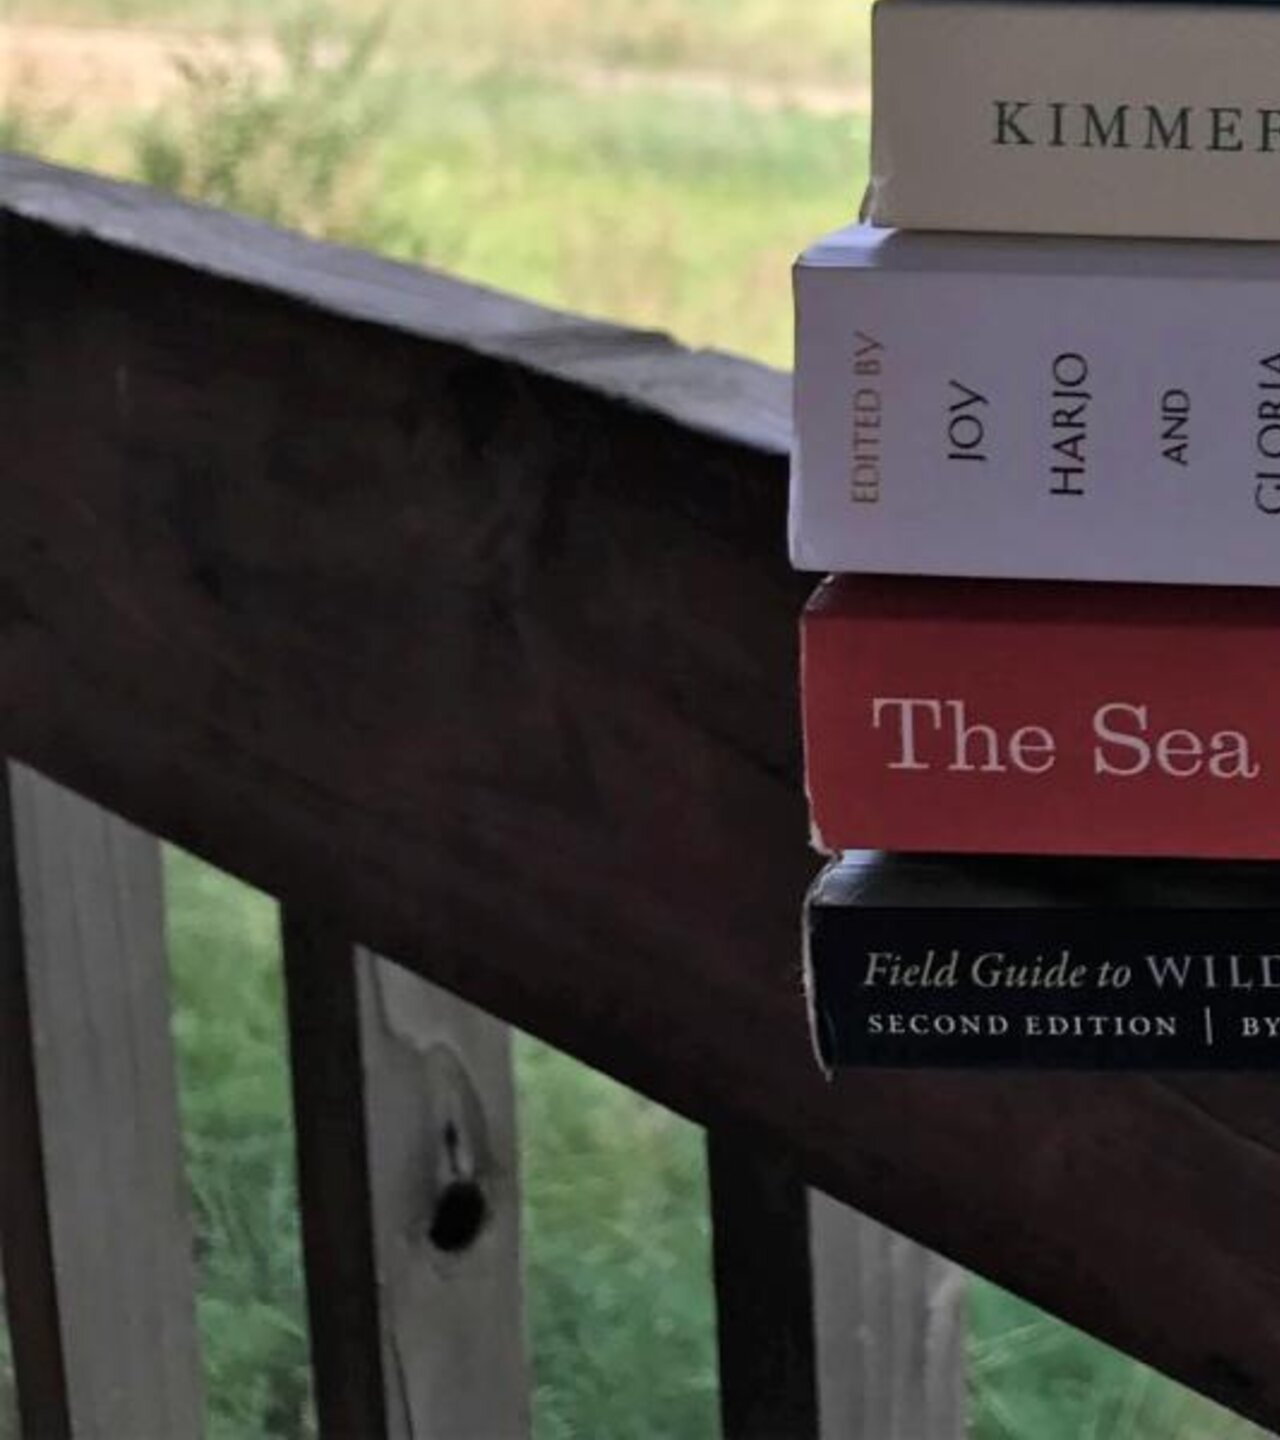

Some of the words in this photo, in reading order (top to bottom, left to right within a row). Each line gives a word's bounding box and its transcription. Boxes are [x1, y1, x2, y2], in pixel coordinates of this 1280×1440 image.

[854, 332, 883, 376] BY
[852, 387, 881, 504] EDITED
[947, 379, 988, 462] JOY
[1050, 352, 1088, 496] HARJO
[1160, 389, 1190, 465] AND
[872, 697, 1056, 772] The
[1092, 702, 1259, 779] Sea
[864, 952, 958, 989] Field
[973, 952, 1086, 990] Guide
[1096, 961, 1131, 990] to
[868, 1013, 1009, 1036] SECOND
[1025, 1013, 1178, 1036] EDITION
